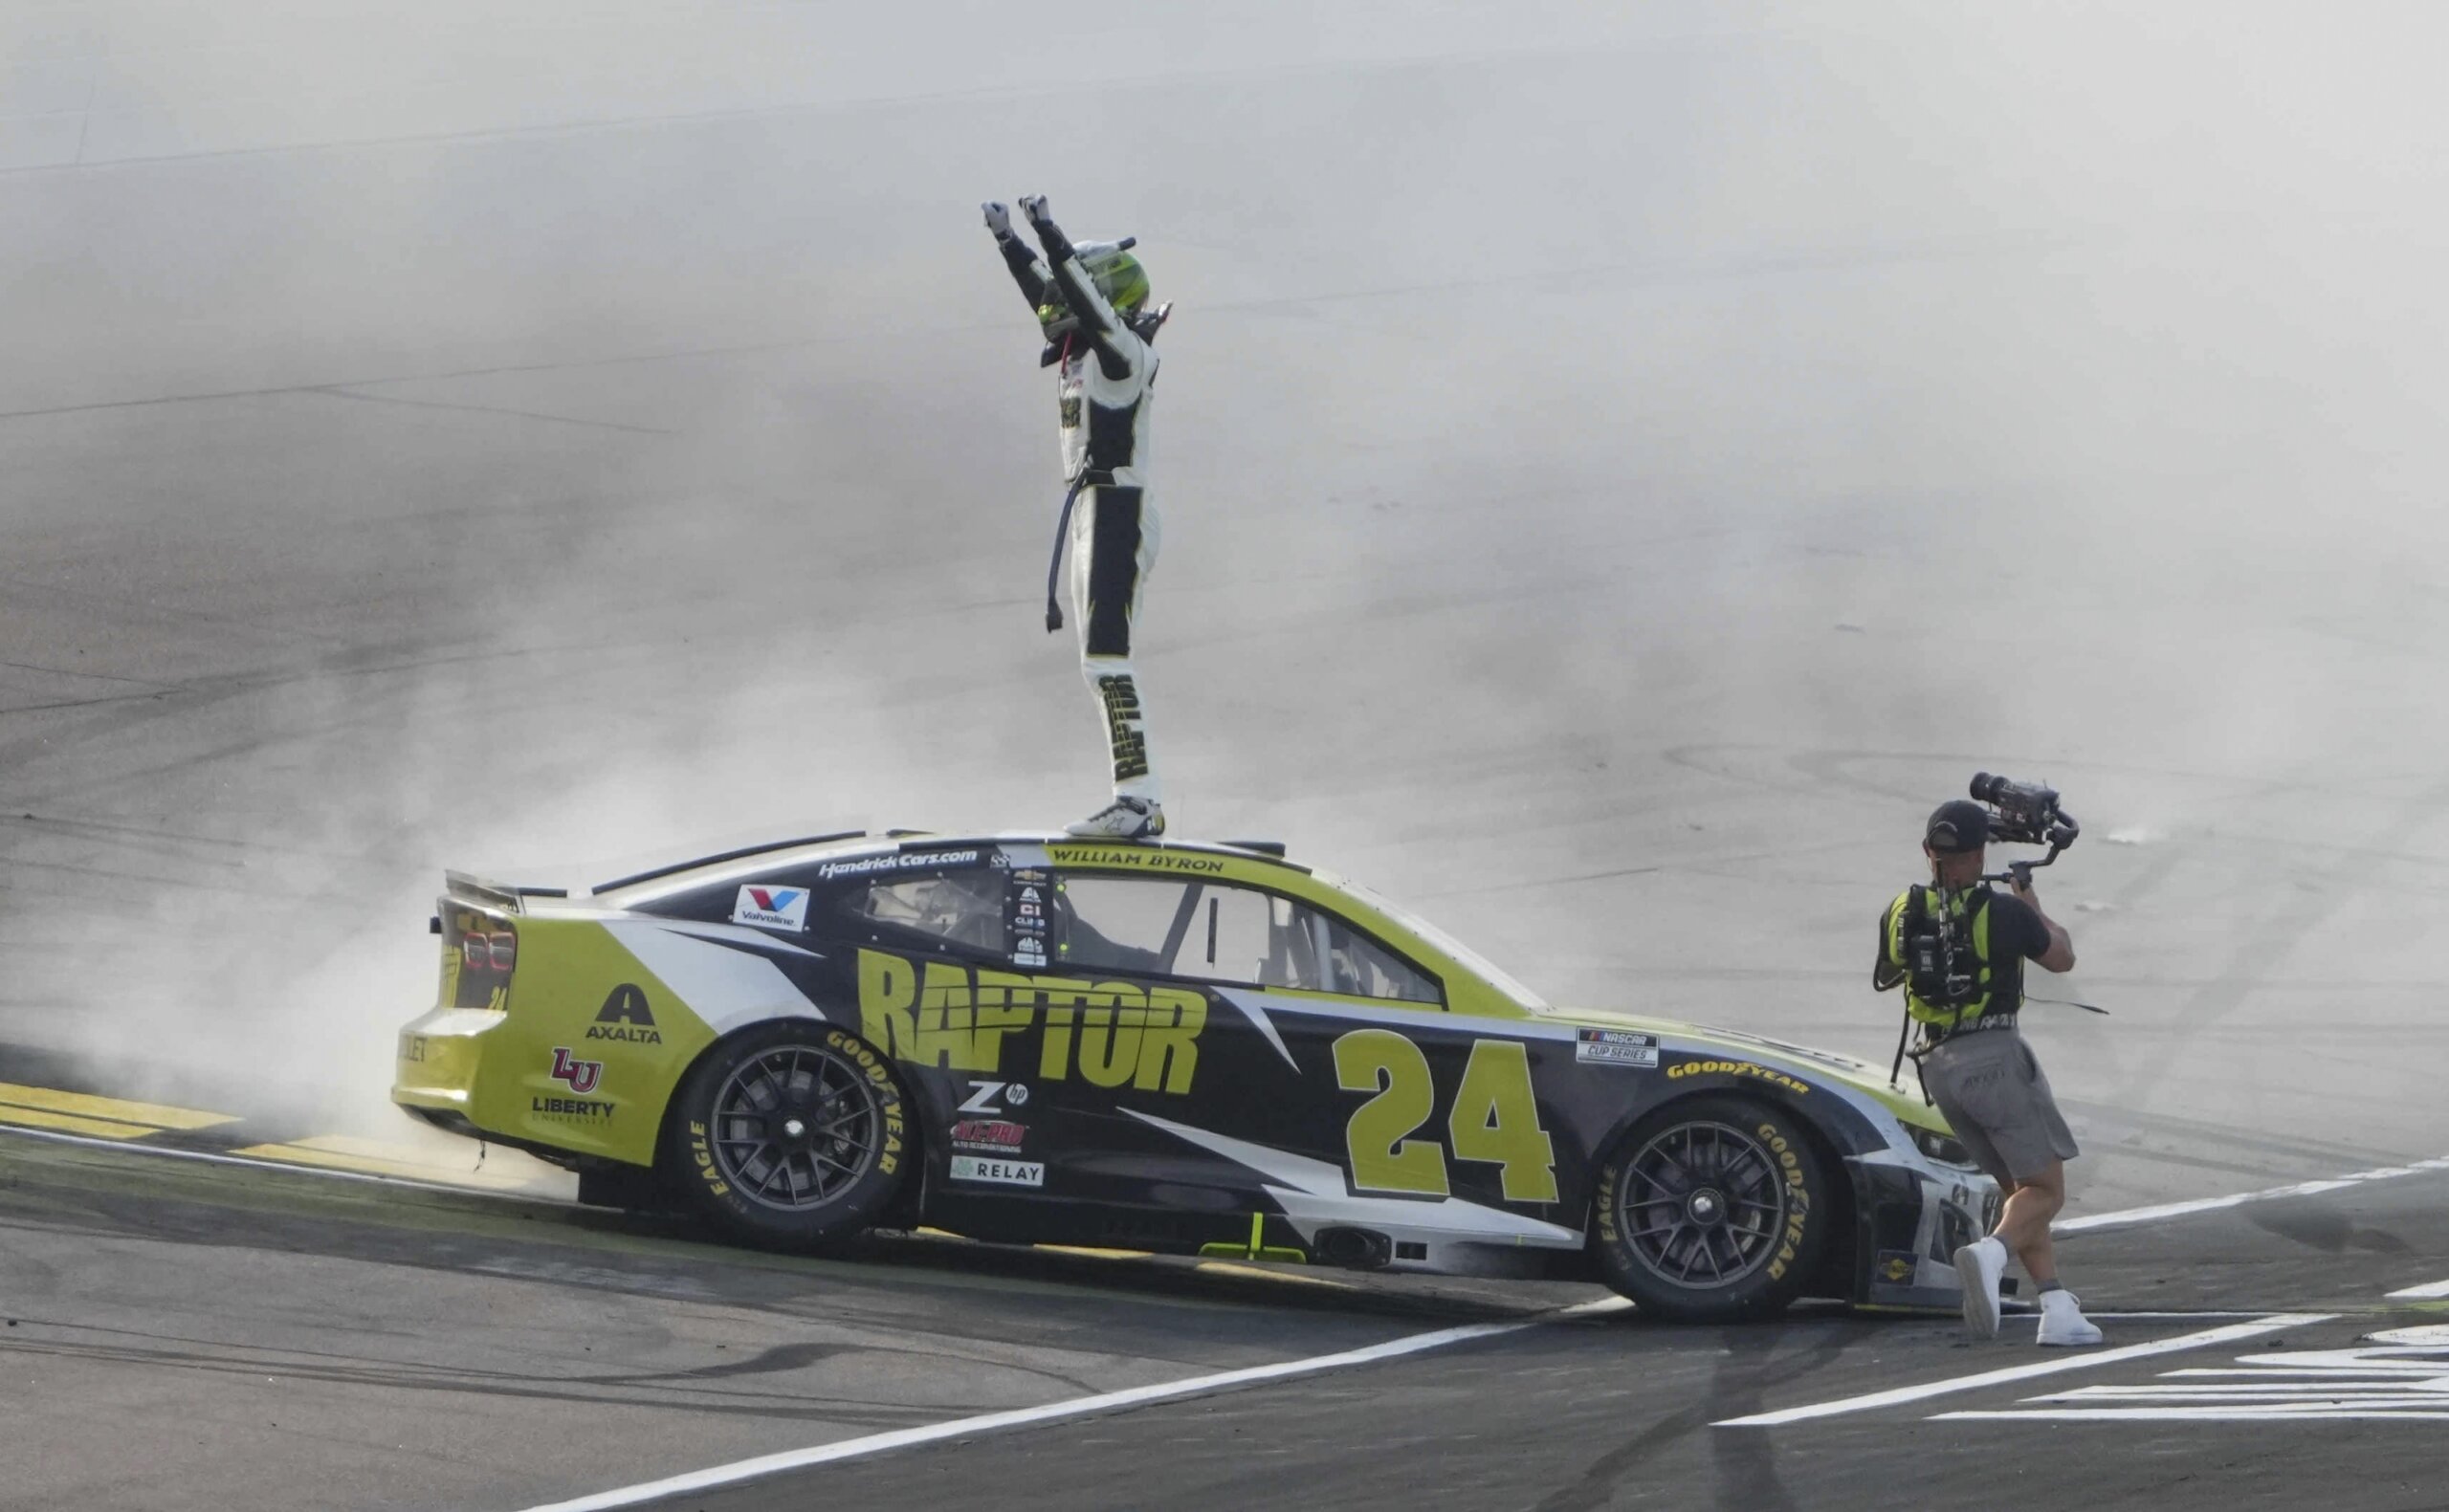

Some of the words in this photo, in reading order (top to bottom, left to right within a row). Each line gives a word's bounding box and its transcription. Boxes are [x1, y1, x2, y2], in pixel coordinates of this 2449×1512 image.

[1099, 674, 1148, 781] RAPTOR
[1053, 849, 1142, 866] WILLIAM
[1148, 854, 1224, 872] BYRON
[742, 909, 795, 925] Valvoline
[585, 1026, 662, 1044] AXALTA
[857, 948, 1207, 1095] RAPTOR
[1588, 1045, 1612, 1057] CUP
[1613, 1046, 1646, 1060] SERIES
[1601, 1031, 1647, 1046] NASCAR
[1666, 1061, 1810, 1094] GOODYEAR
[532, 1097, 616, 1118] LIBERTY
[827, 1031, 903, 1174] GOODYEAR
[957, 1081, 1007, 1114] Z
[1332, 1028, 1559, 1203] 24
[690, 1120, 729, 1196] EAGLE
[977, 1163, 1040, 1180] RELAY
[1598, 1165, 1619, 1241] EAGLE
[1758, 1124, 1809, 1280] GOODYEAR
